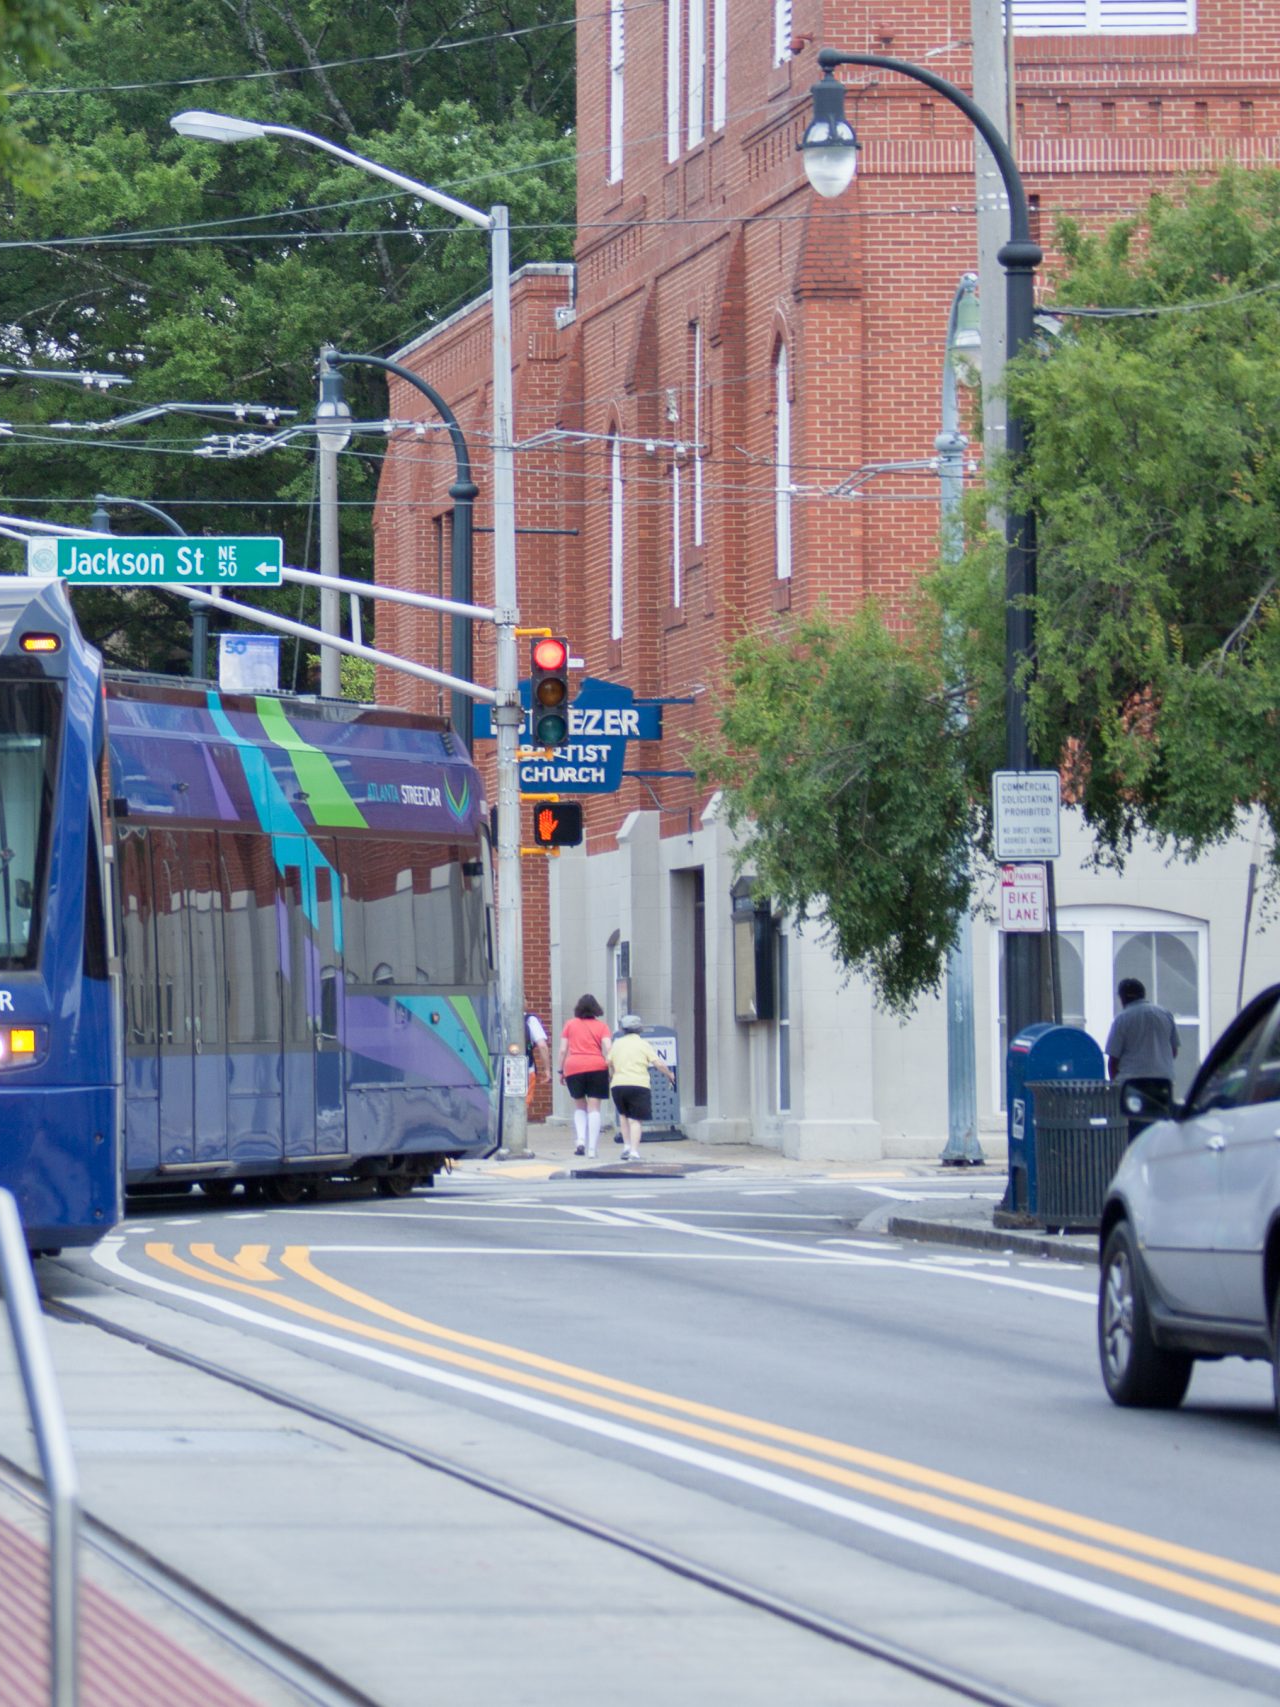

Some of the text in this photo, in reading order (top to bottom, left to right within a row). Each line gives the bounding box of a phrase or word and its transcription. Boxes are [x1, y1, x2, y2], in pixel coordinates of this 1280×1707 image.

[218, 546, 237, 560] NE
[62, 546, 205, 576] Jackson St
[218, 562, 237, 577] 50
[521, 766, 606, 783] CHURCH
[1002, 782, 1051, 792] COMMERCIAL
[367, 783, 442, 807] ATLANTA STREETCAR
[1001, 795, 1053, 804] SOLICITATION
[1005, 808, 1051, 817] PROHIBITED
[1008, 892, 1037, 904] BIKE
[1008, 909, 1039, 921] LANE
